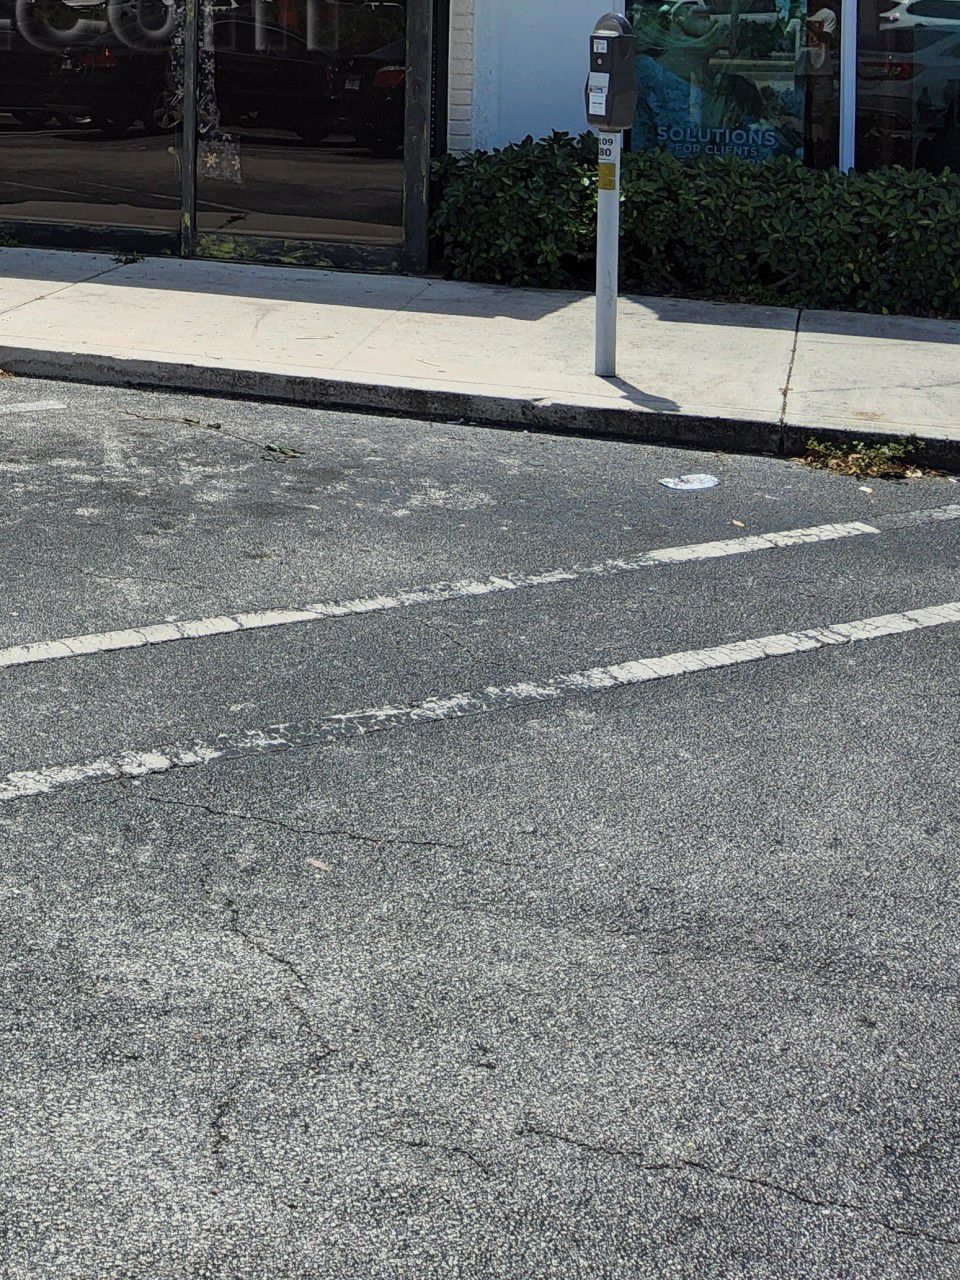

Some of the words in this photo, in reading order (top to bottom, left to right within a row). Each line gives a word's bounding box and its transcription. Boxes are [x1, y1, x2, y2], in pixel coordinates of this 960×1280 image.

[657, 127, 776, 146] SOLUTIONS
[675, 144, 700, 154] FOR
[705, 145, 757, 156] CLIENTS
